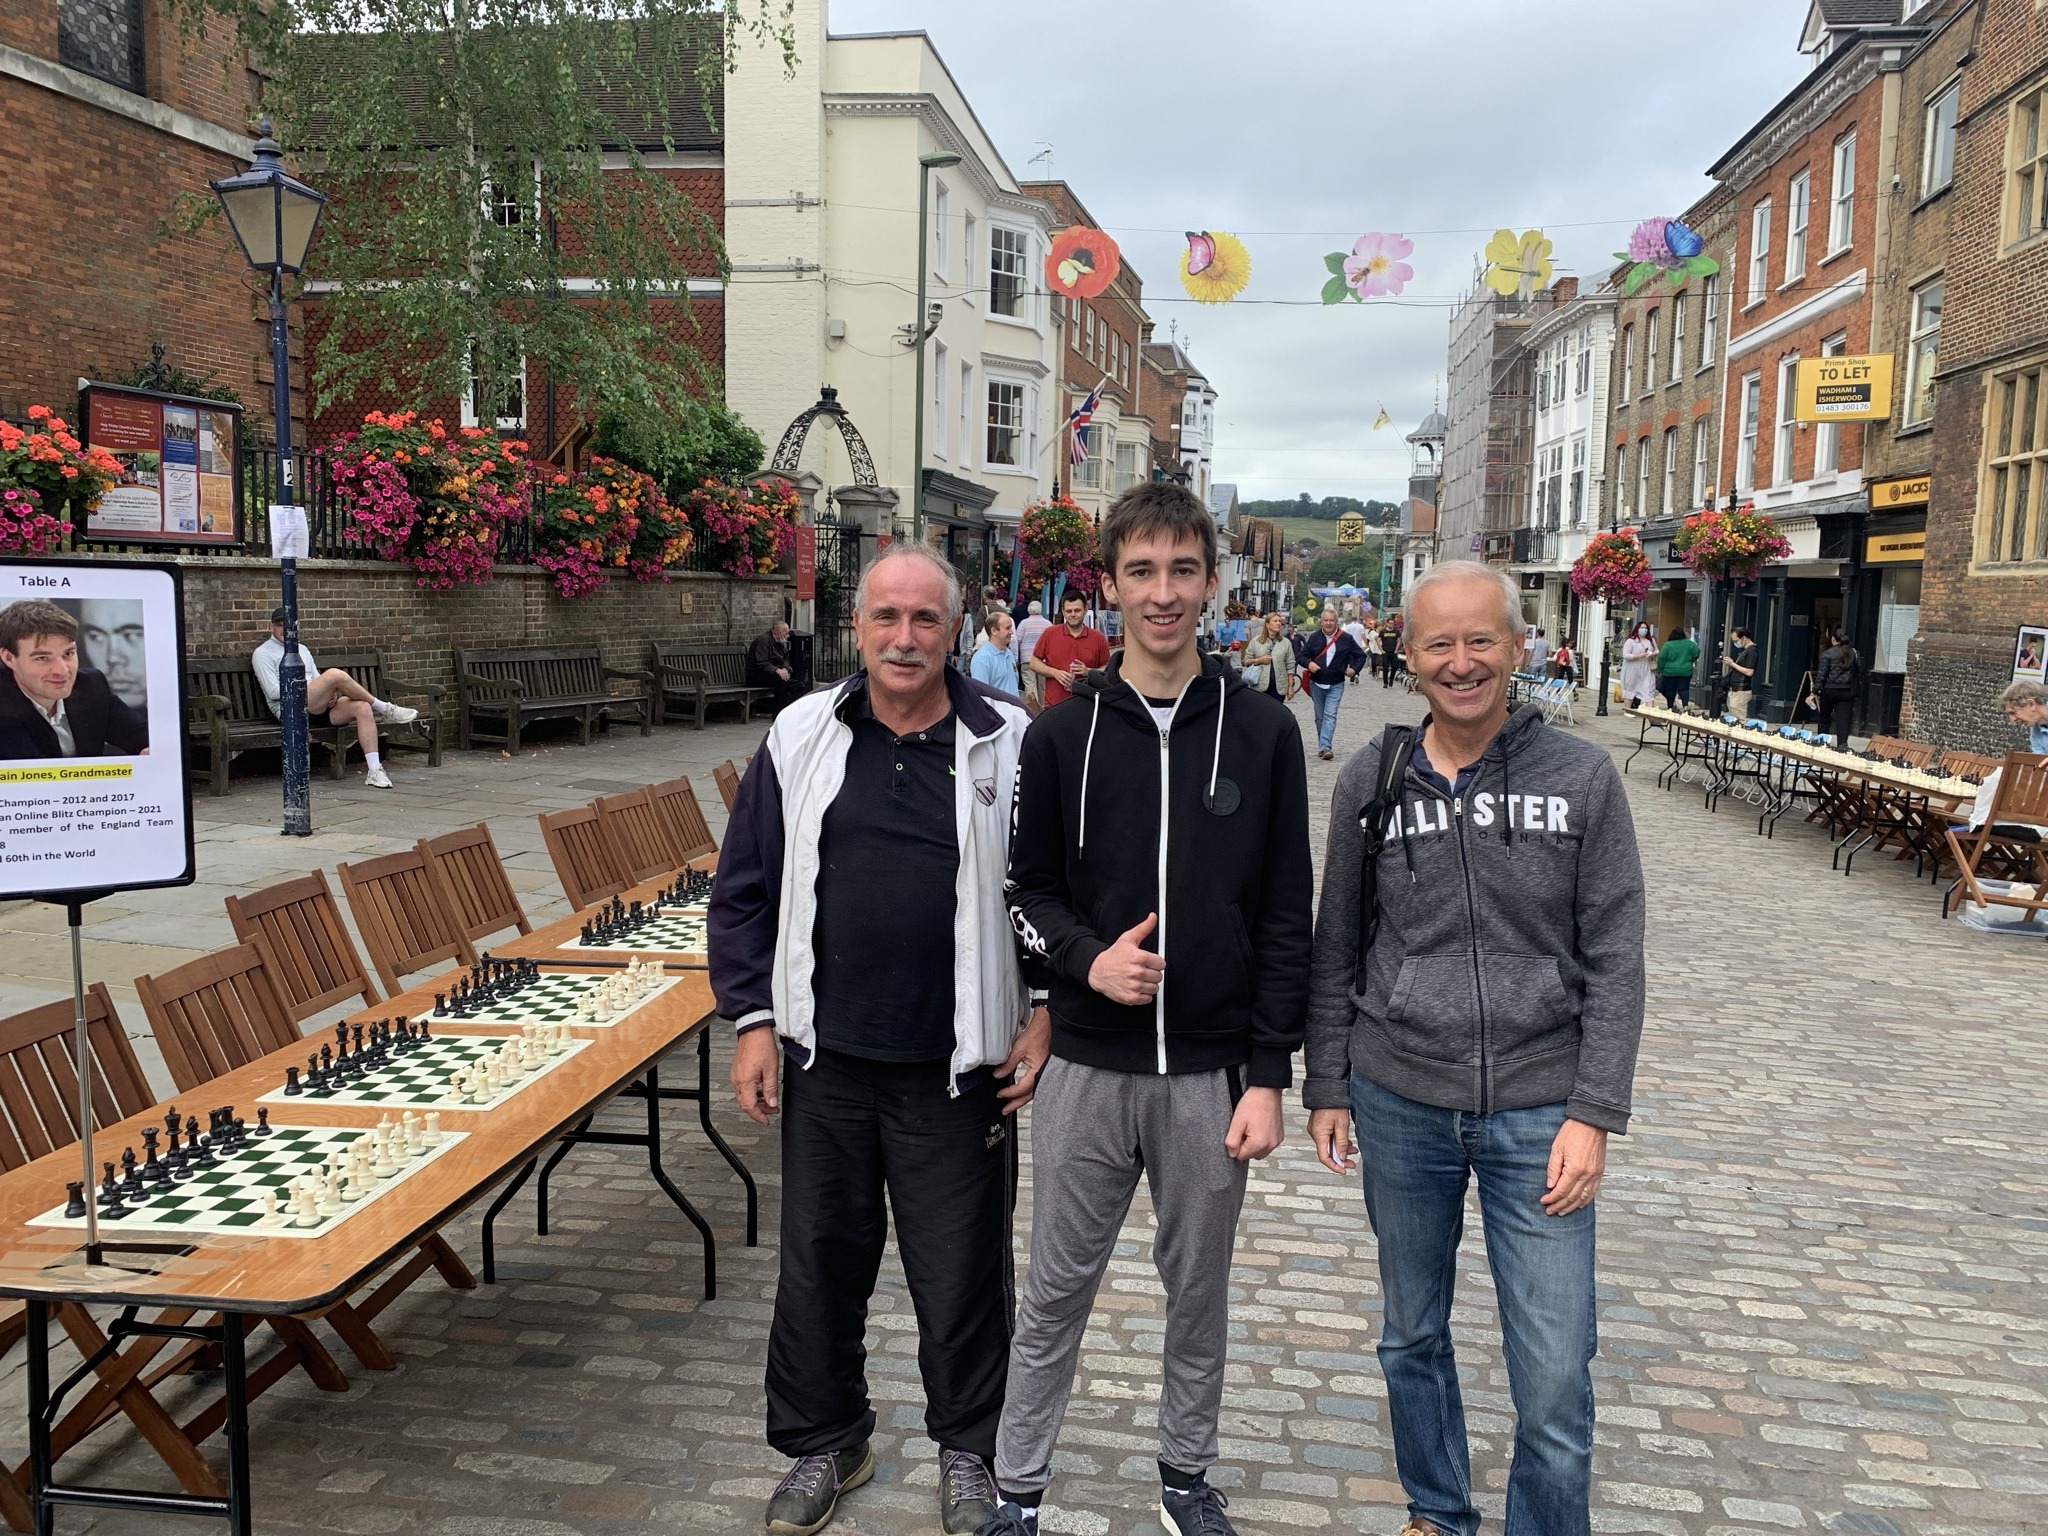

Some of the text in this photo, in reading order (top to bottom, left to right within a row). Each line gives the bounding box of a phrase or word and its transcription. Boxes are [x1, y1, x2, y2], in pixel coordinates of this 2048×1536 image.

[1848, 358, 1867, 366] Shop
[1819, 366, 1871, 381] TO LET
[1819, 386, 1852, 395] WADHAM
[1818, 394, 1863, 403] ISHERWOOD
[1816, 403, 1869, 412] 01483 300176
[287, 461, 292, 472] 1
[286, 473, 293, 485] 2
[1901, 482, 1929, 495] JACKS
[19, 575, 71, 587] Table A
[20, 771, 57, 780] Jones,
[59, 768, 133, 778] Grandmaster
[62, 795, 87, 805] 2012
[89, 794, 108, 803] and
[111, 793, 135, 802] 2017
[14, 811, 49, 821] Online
[52, 810, 74, 819] Blitz
[76, 807, 127, 818] Champion
[138, 805, 162, 814] 2021
[9, 825, 53, 835] member
[60, 823, 71, 832] of
[77, 822, 94, 831] the
[101, 819, 140, 830] England
[146, 818, 174, 827] Team
[5, 853, 30, 863] 60th
[32, 852, 42, 861] in
[44, 851, 62, 860] the
[64, 848, 96, 859] World
